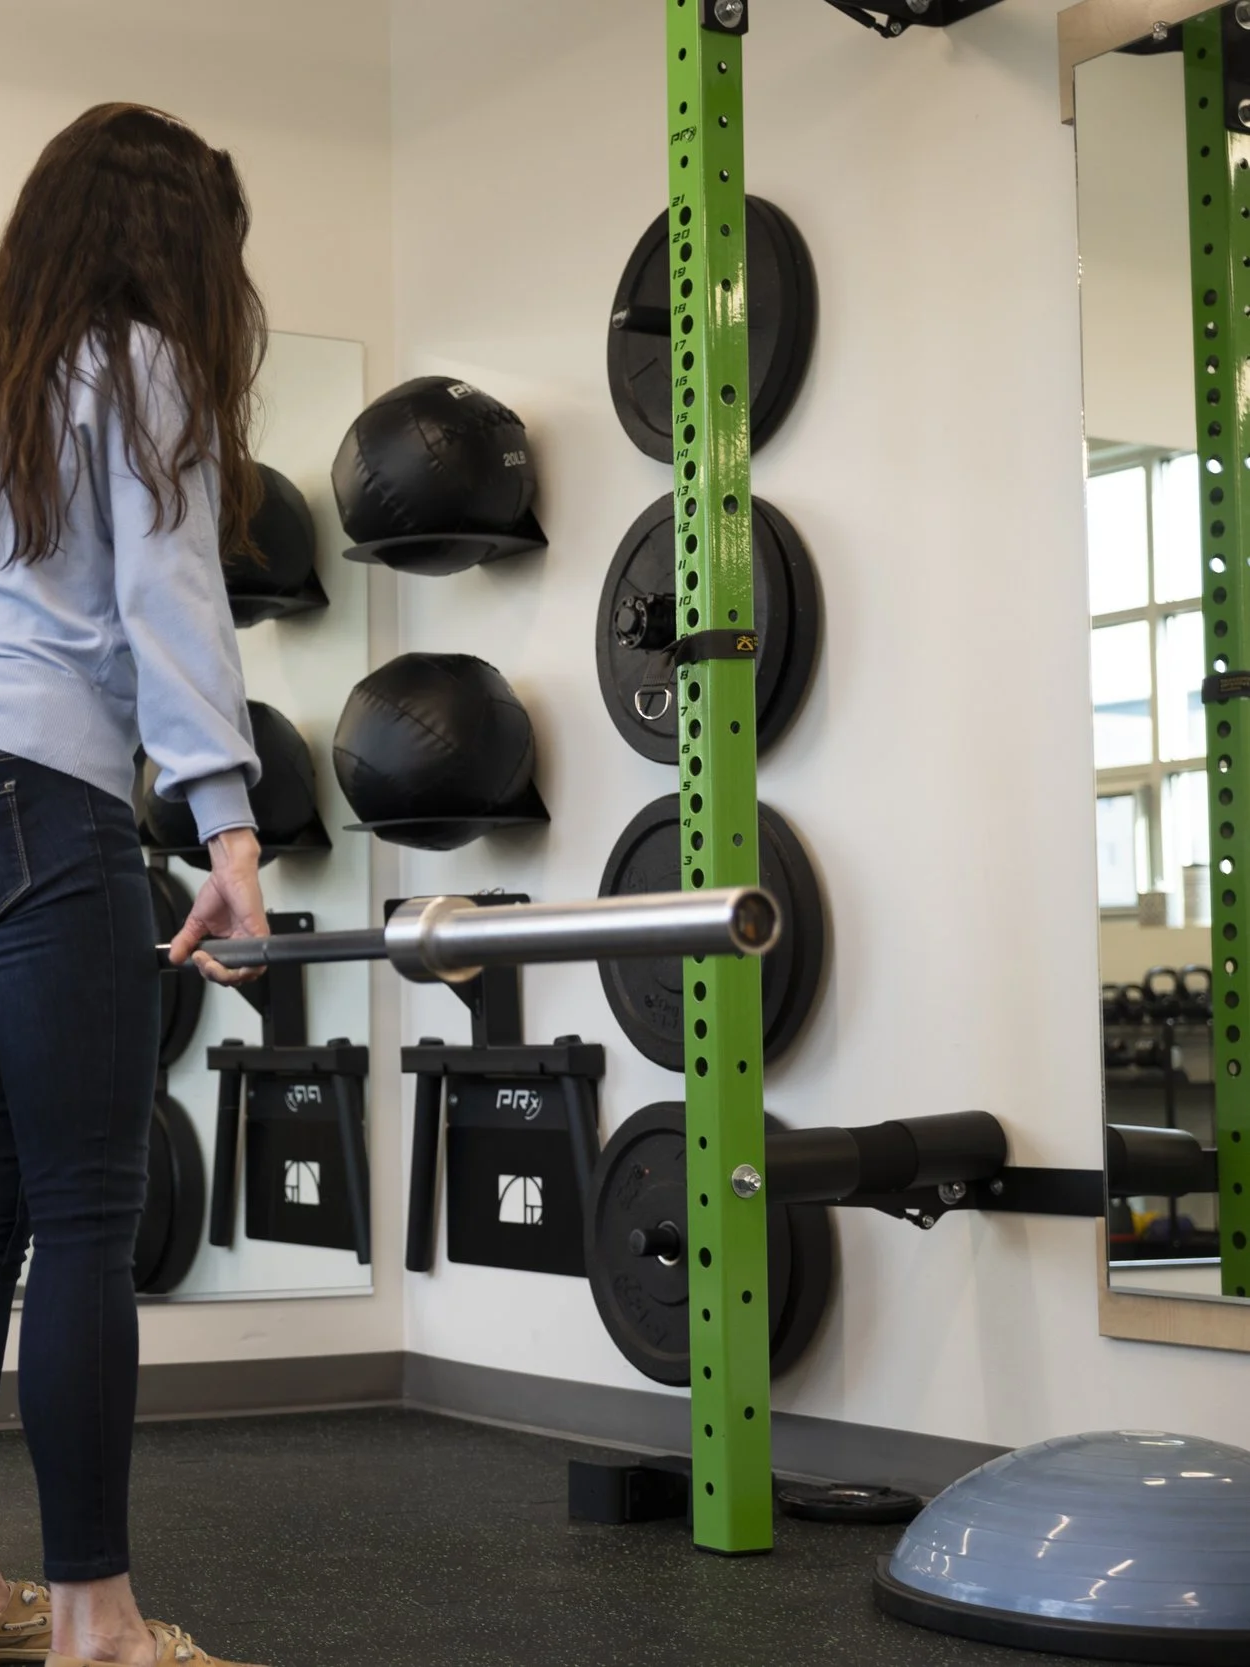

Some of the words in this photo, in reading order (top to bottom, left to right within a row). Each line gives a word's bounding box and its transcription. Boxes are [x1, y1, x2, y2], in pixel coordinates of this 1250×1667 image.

[672, 194, 684, 207] 21
[673, 229, 690, 243] 20
[673, 267, 686, 279] 19
[674, 303, 686, 315] 18
[674, 340, 686, 352] 17
[675, 376, 687, 388] 16
[676, 412, 688, 424] 15
[676, 449, 688, 460] 14
[677, 486, 689, 497] 13
[678, 522, 690, 533] 12
[678, 560, 686, 570] 11
[679, 596, 691, 607] 10
[680, 670, 689, 680] 8
[680, 707, 688, 716] 7
[681, 744, 690, 754] 6
[682, 781, 691, 791] 5
[683, 818, 691, 828] 4
[683, 856, 692, 865] 3
